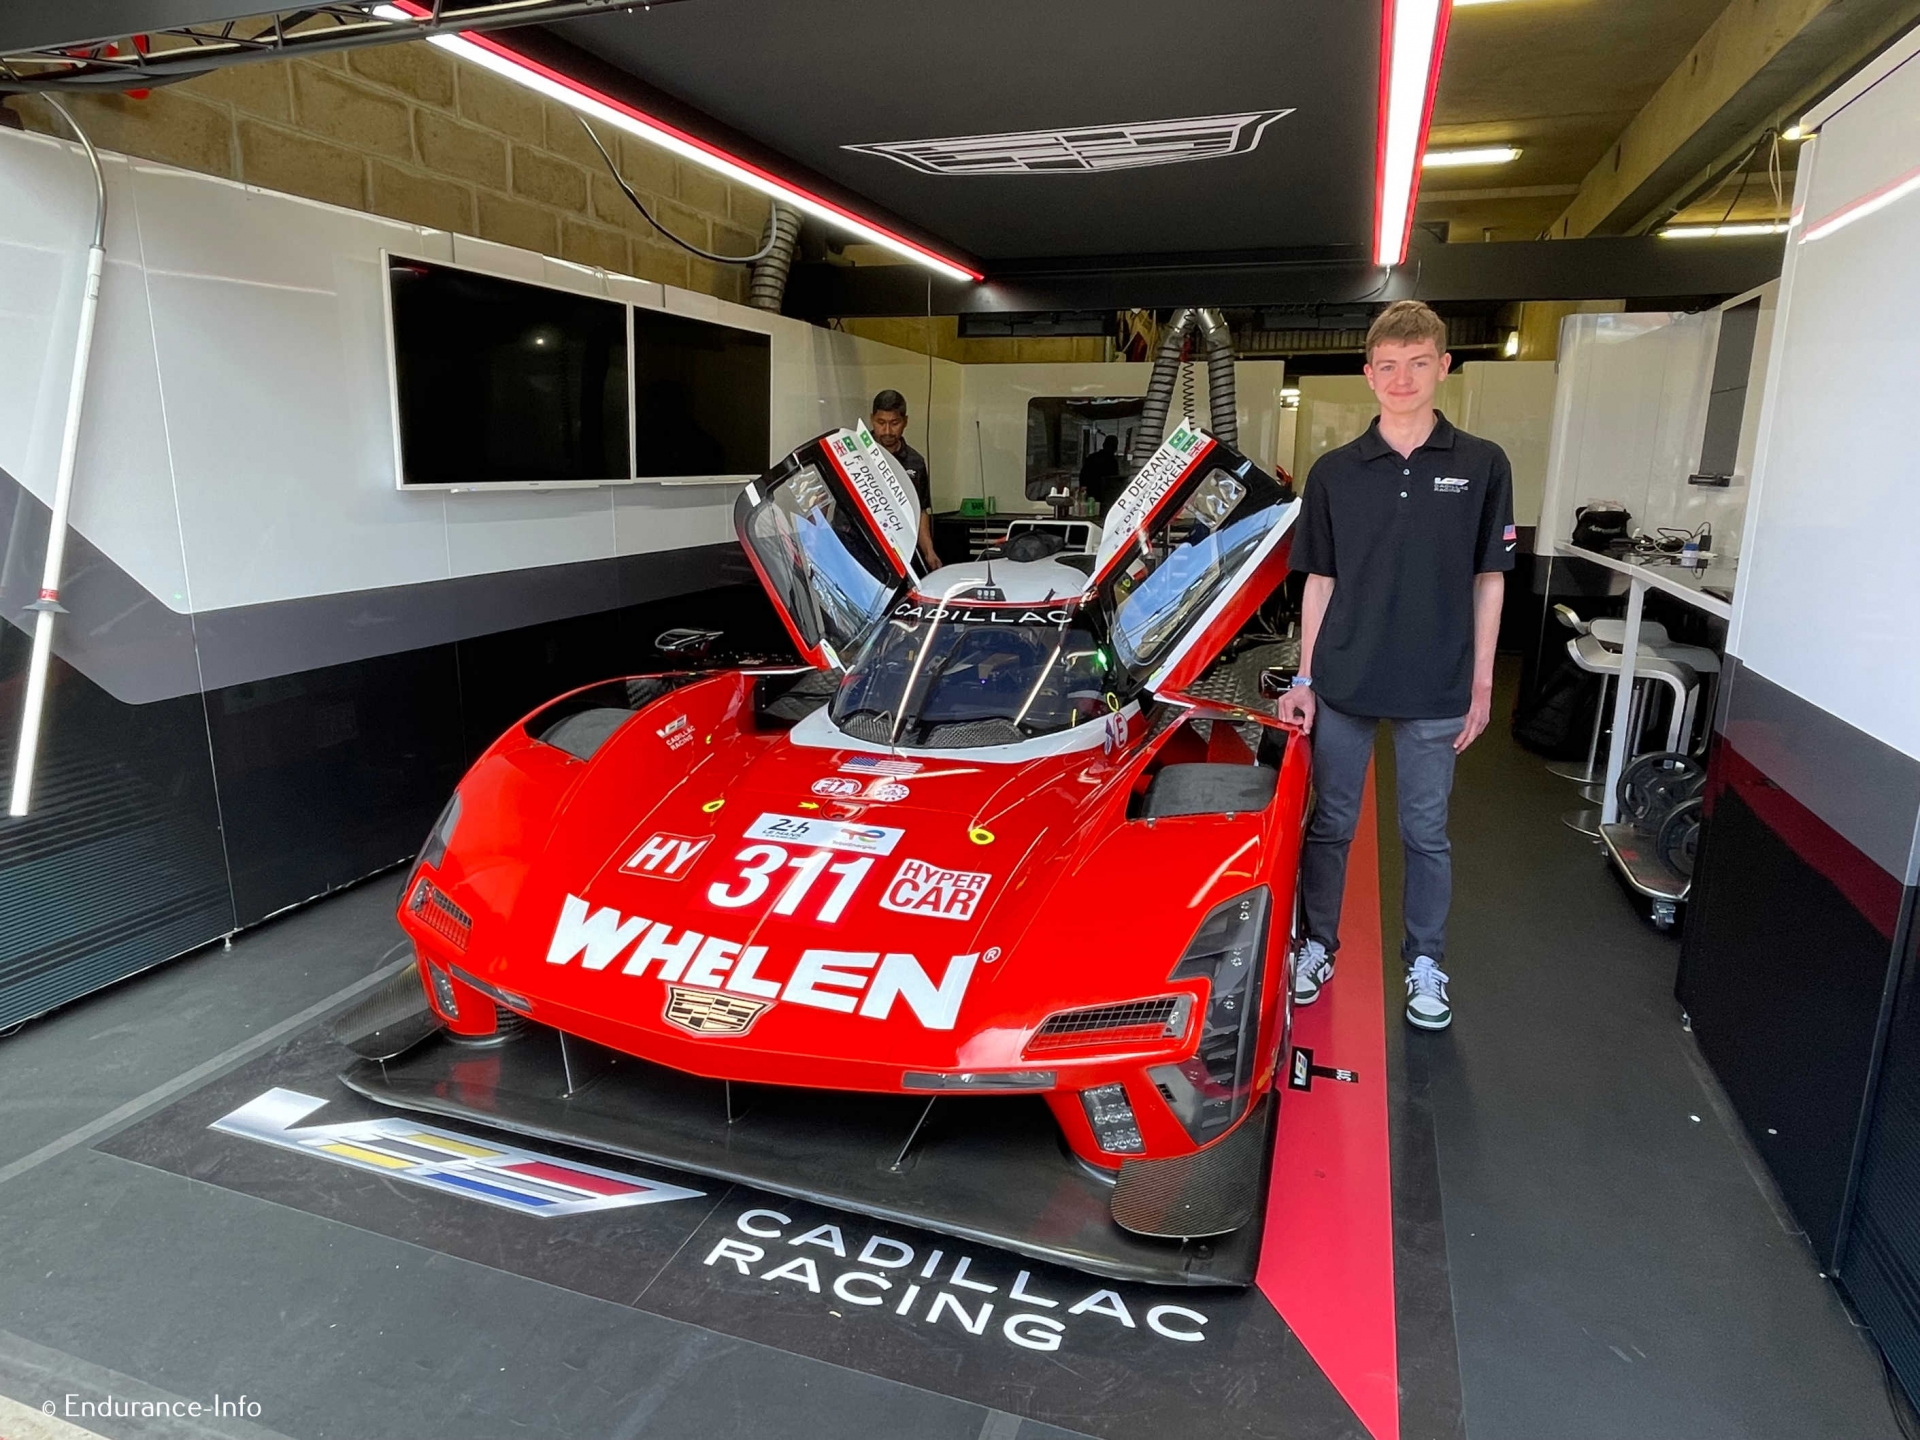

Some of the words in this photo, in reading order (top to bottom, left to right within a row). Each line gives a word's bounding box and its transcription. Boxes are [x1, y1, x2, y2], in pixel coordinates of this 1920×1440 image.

[851, 472, 883, 514] AITKEN
[877, 460, 908, 506] DERANI
[1128, 448, 1171, 497] DERANI
[1149, 460, 1188, 507] AITKEN
[860, 466, 904, 532] DRUGOVICH
[894, 603, 1073, 623] CADILLAC
[666, 725, 696, 746] CADILLAC
[670, 734, 694, 751] RACING
[814, 779, 856, 795] FIA
[625, 837, 710, 872] HY
[901, 860, 986, 891] HYPER
[706, 845, 876, 924] 311
[886, 878, 976, 917] CAR
[546, 894, 980, 1030] WHELEN
[703, 1237, 1066, 1351] RACING
[737, 1208, 1209, 1343] CADILLAC
